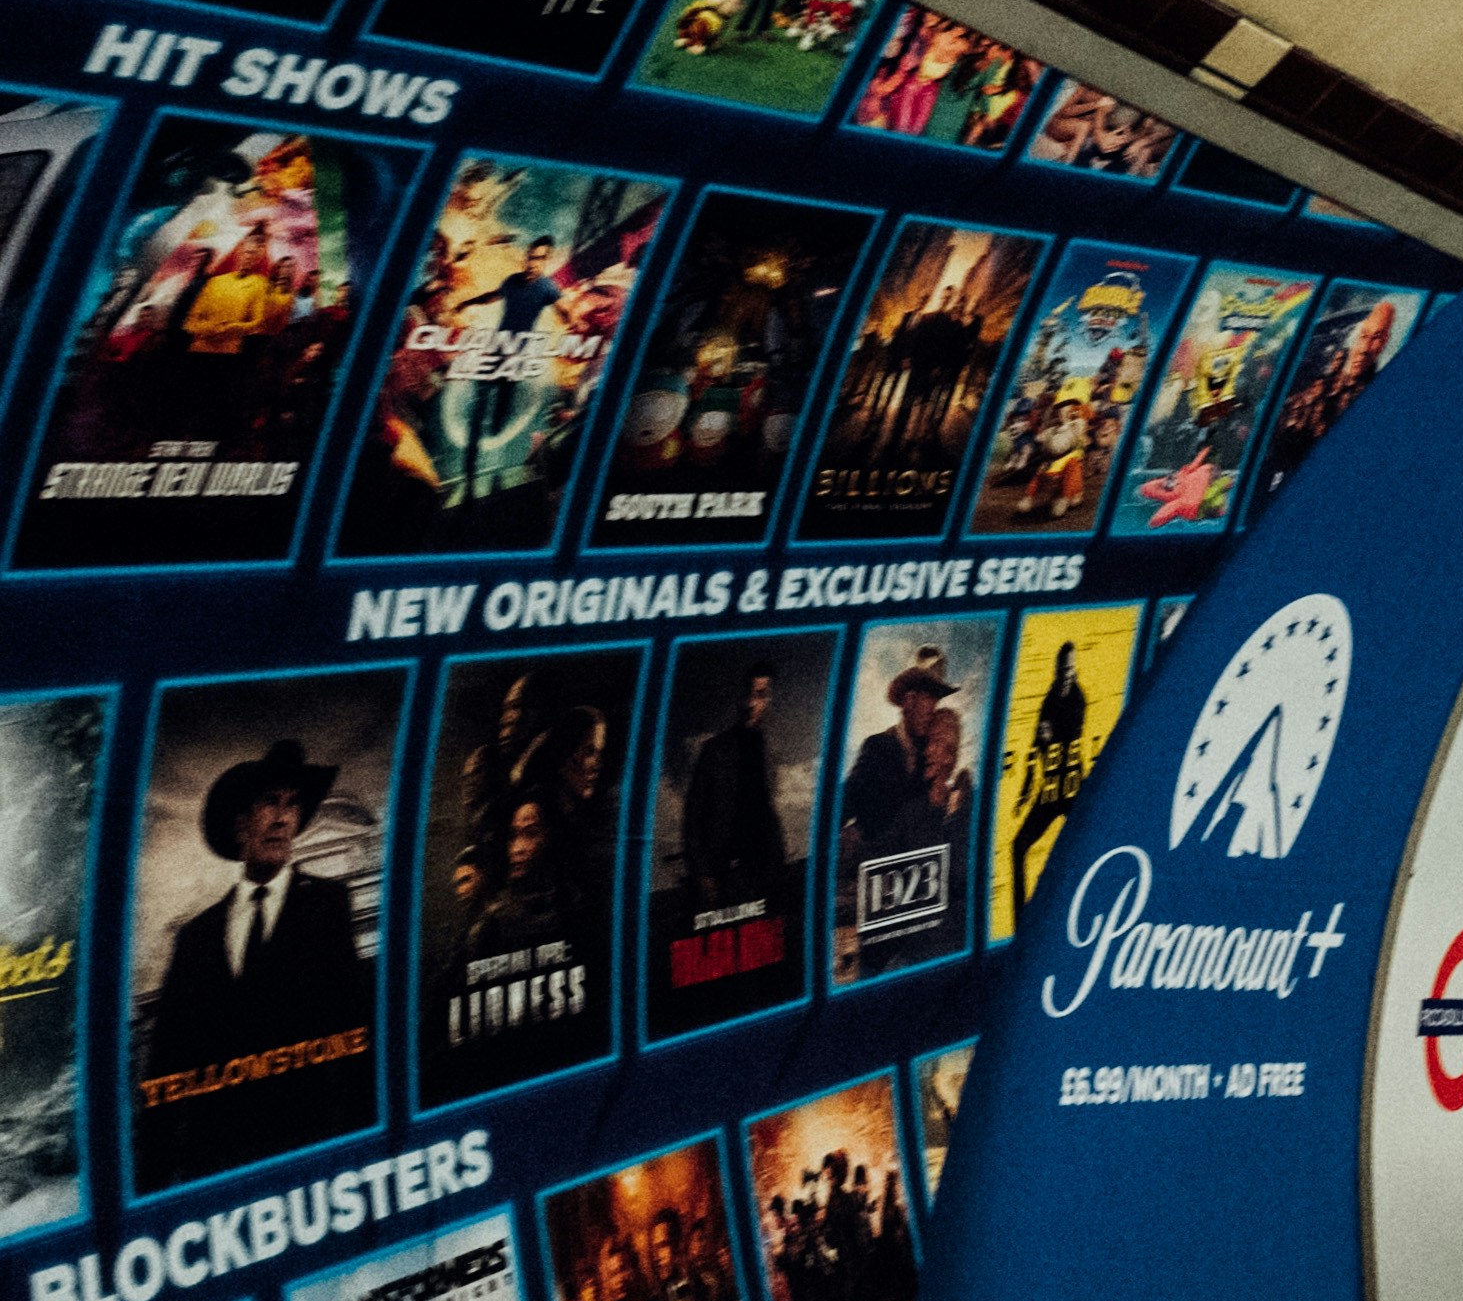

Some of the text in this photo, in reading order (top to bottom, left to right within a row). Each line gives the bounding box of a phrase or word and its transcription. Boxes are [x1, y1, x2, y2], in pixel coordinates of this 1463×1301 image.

[83, 24, 461, 126] HIT SHOWS
[346, 554, 1085, 642] NEW ORIGINALS & EXCLUSIVE SERIES
[867, 860, 941, 914] 1923
[140, 1026, 370, 1108] YELLOWSTONE
[1256, 1062, 1306, 1098] FREE
